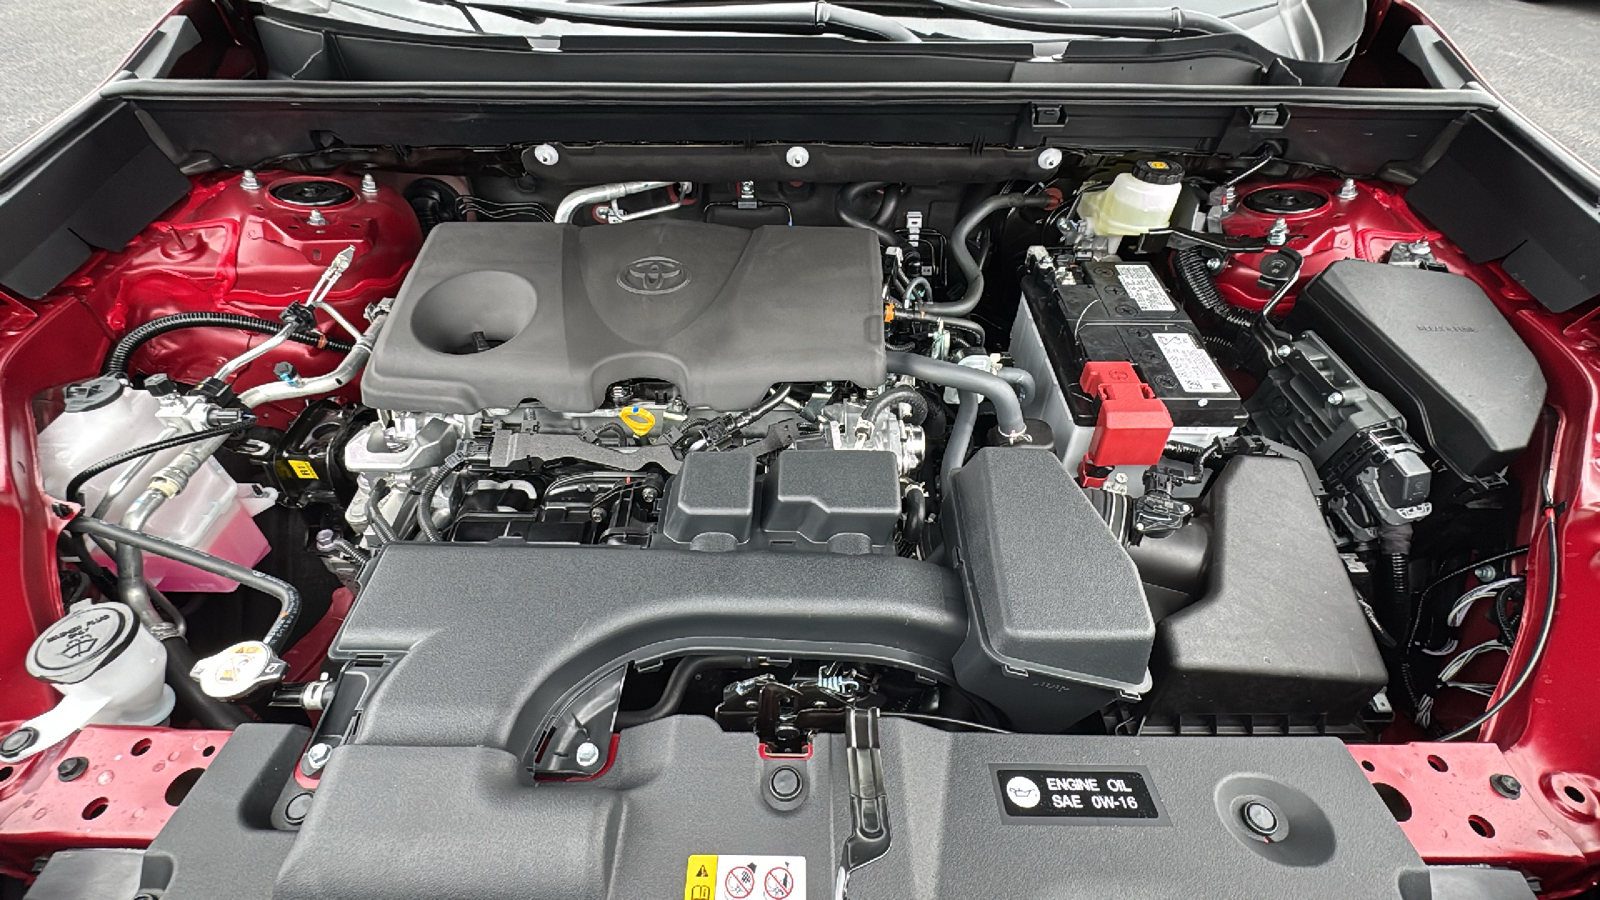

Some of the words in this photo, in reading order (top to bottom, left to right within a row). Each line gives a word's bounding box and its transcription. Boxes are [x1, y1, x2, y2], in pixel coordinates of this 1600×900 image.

[1046, 777, 1101, 791] ENGINE
[1106, 778, 1133, 793] OIL
[1051, 794, 1084, 809] SAE
[1091, 795, 1138, 809] 0W-16
